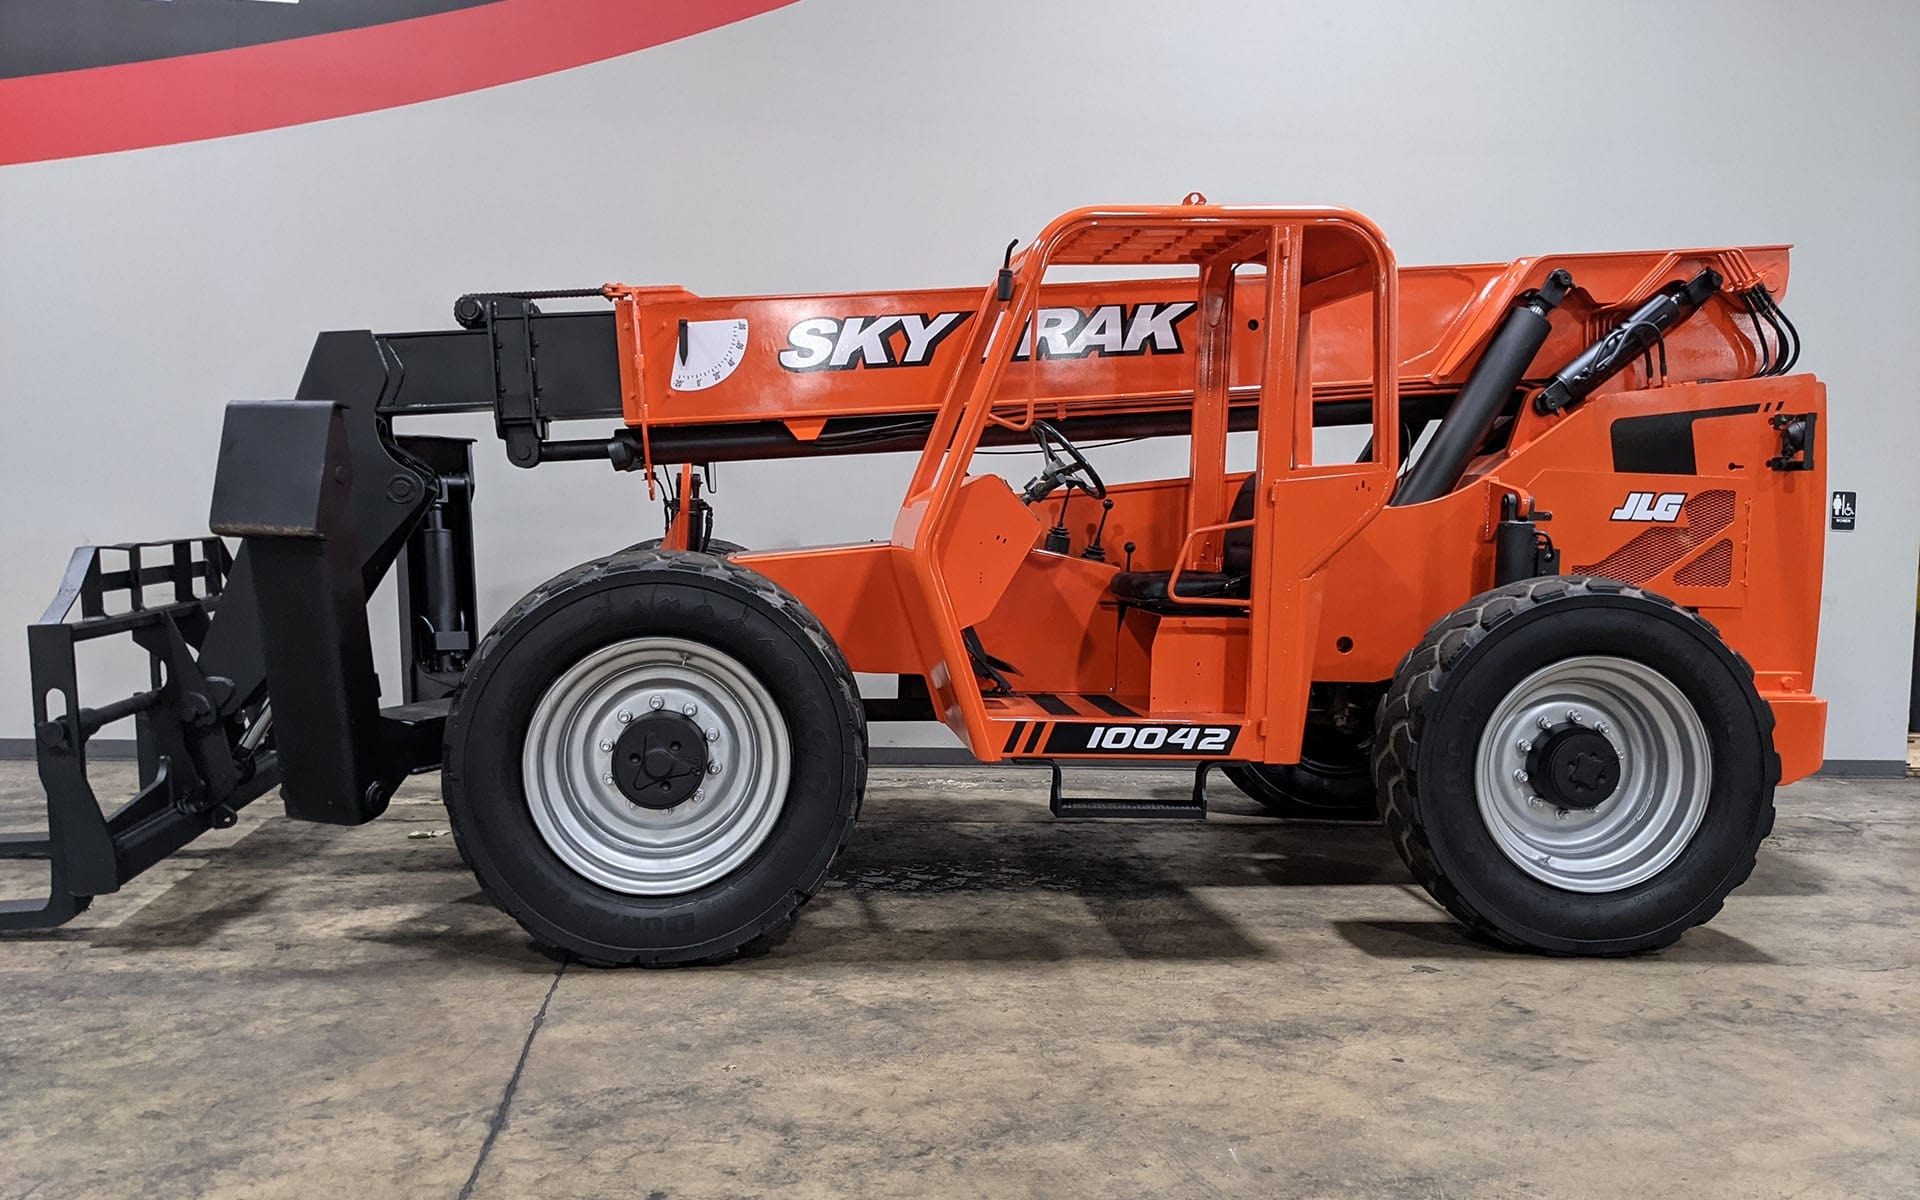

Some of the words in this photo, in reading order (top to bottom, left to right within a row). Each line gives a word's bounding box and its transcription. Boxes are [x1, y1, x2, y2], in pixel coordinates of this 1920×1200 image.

[779, 311, 968, 369] SKY
[1610, 492, 1687, 522] JLG
[1086, 726, 1231, 750] 10042
